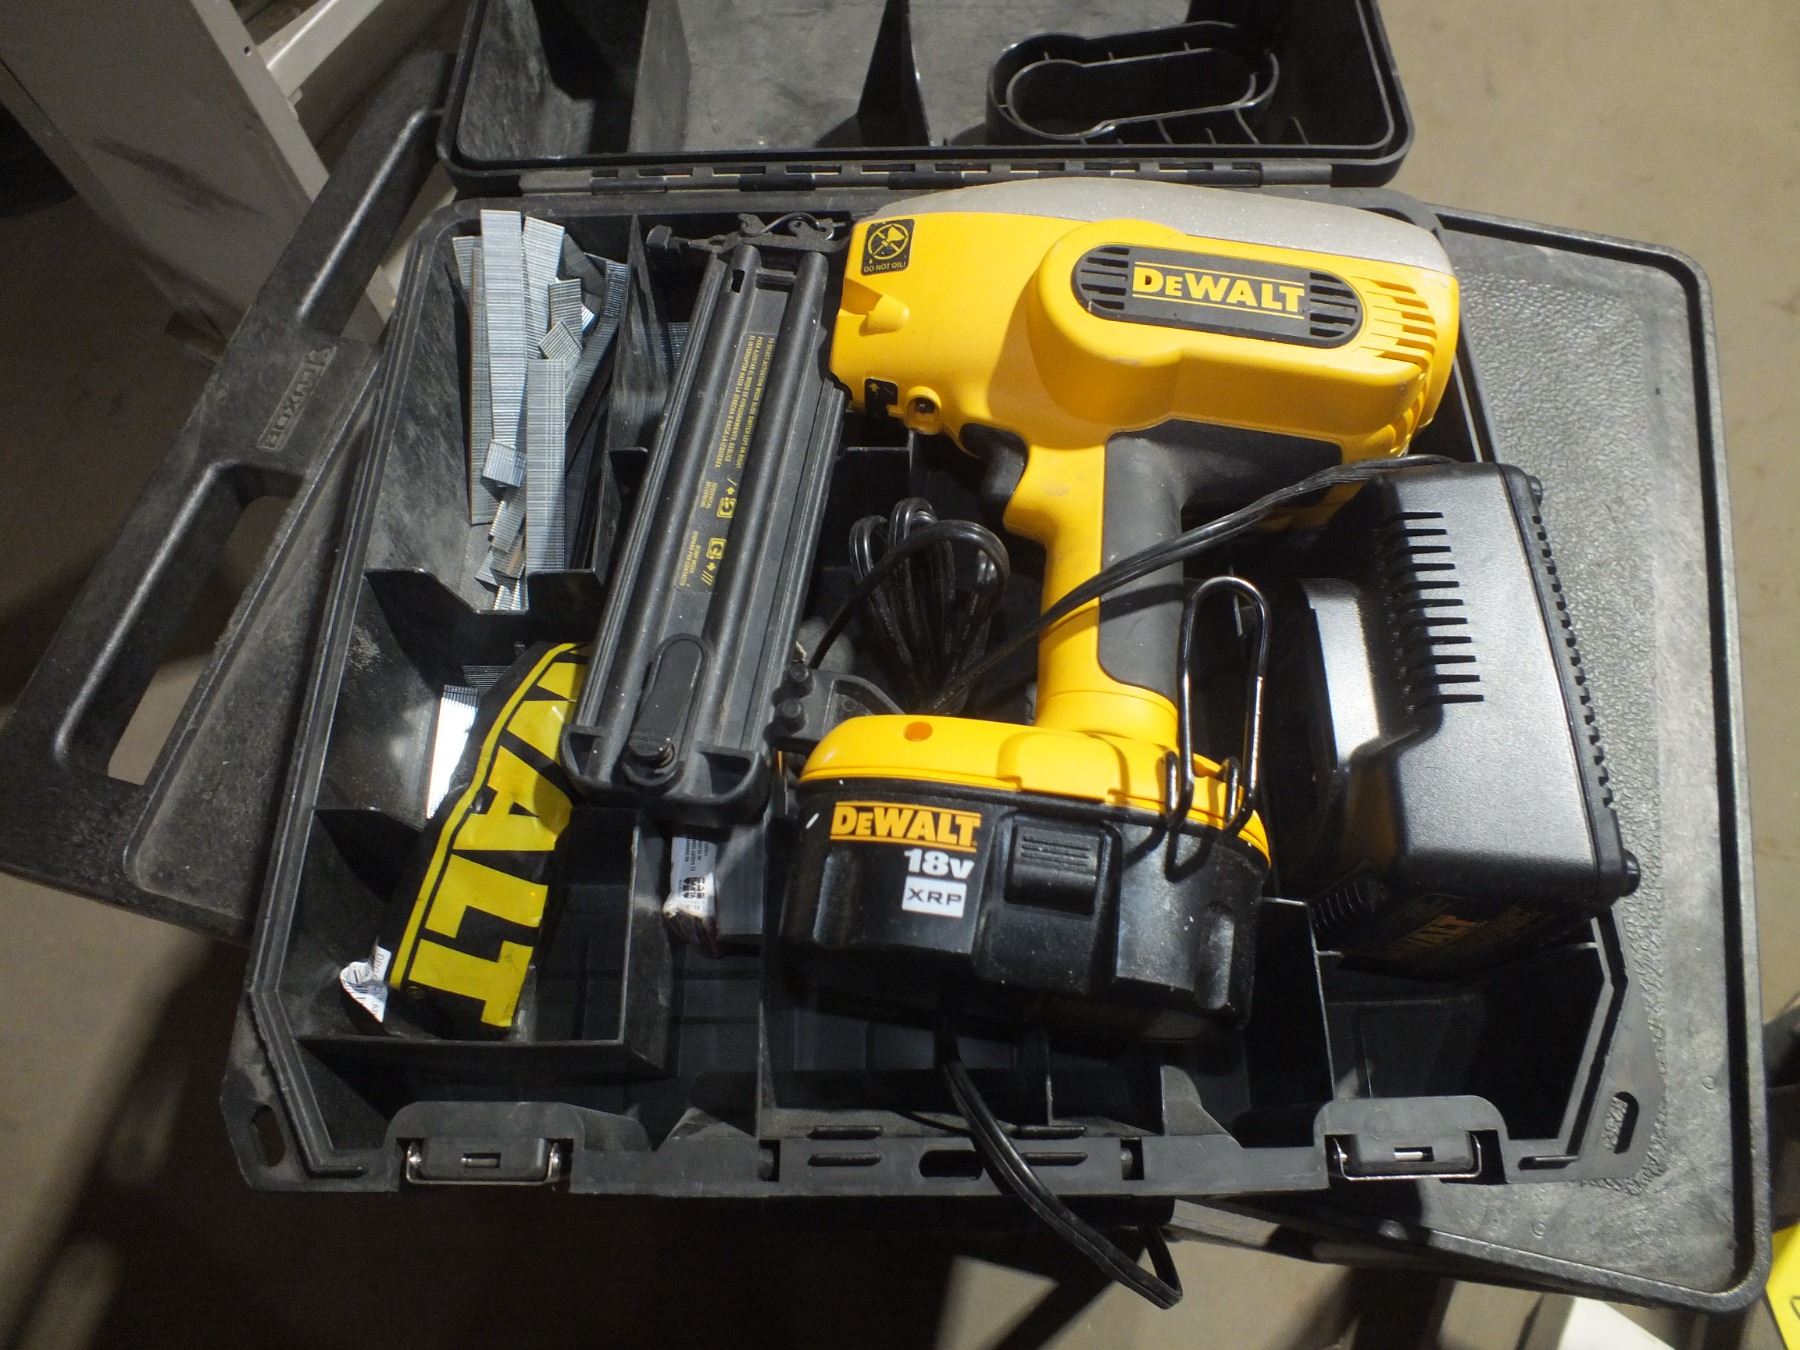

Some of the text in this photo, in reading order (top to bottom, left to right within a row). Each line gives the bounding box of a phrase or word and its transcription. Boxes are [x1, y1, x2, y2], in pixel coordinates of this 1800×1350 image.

[876, 263, 890, 271] NOT
[1132, 266, 1305, 313] DEWALT
[831, 806, 981, 847] DEWALT
[907, 887, 962, 905] XRP
